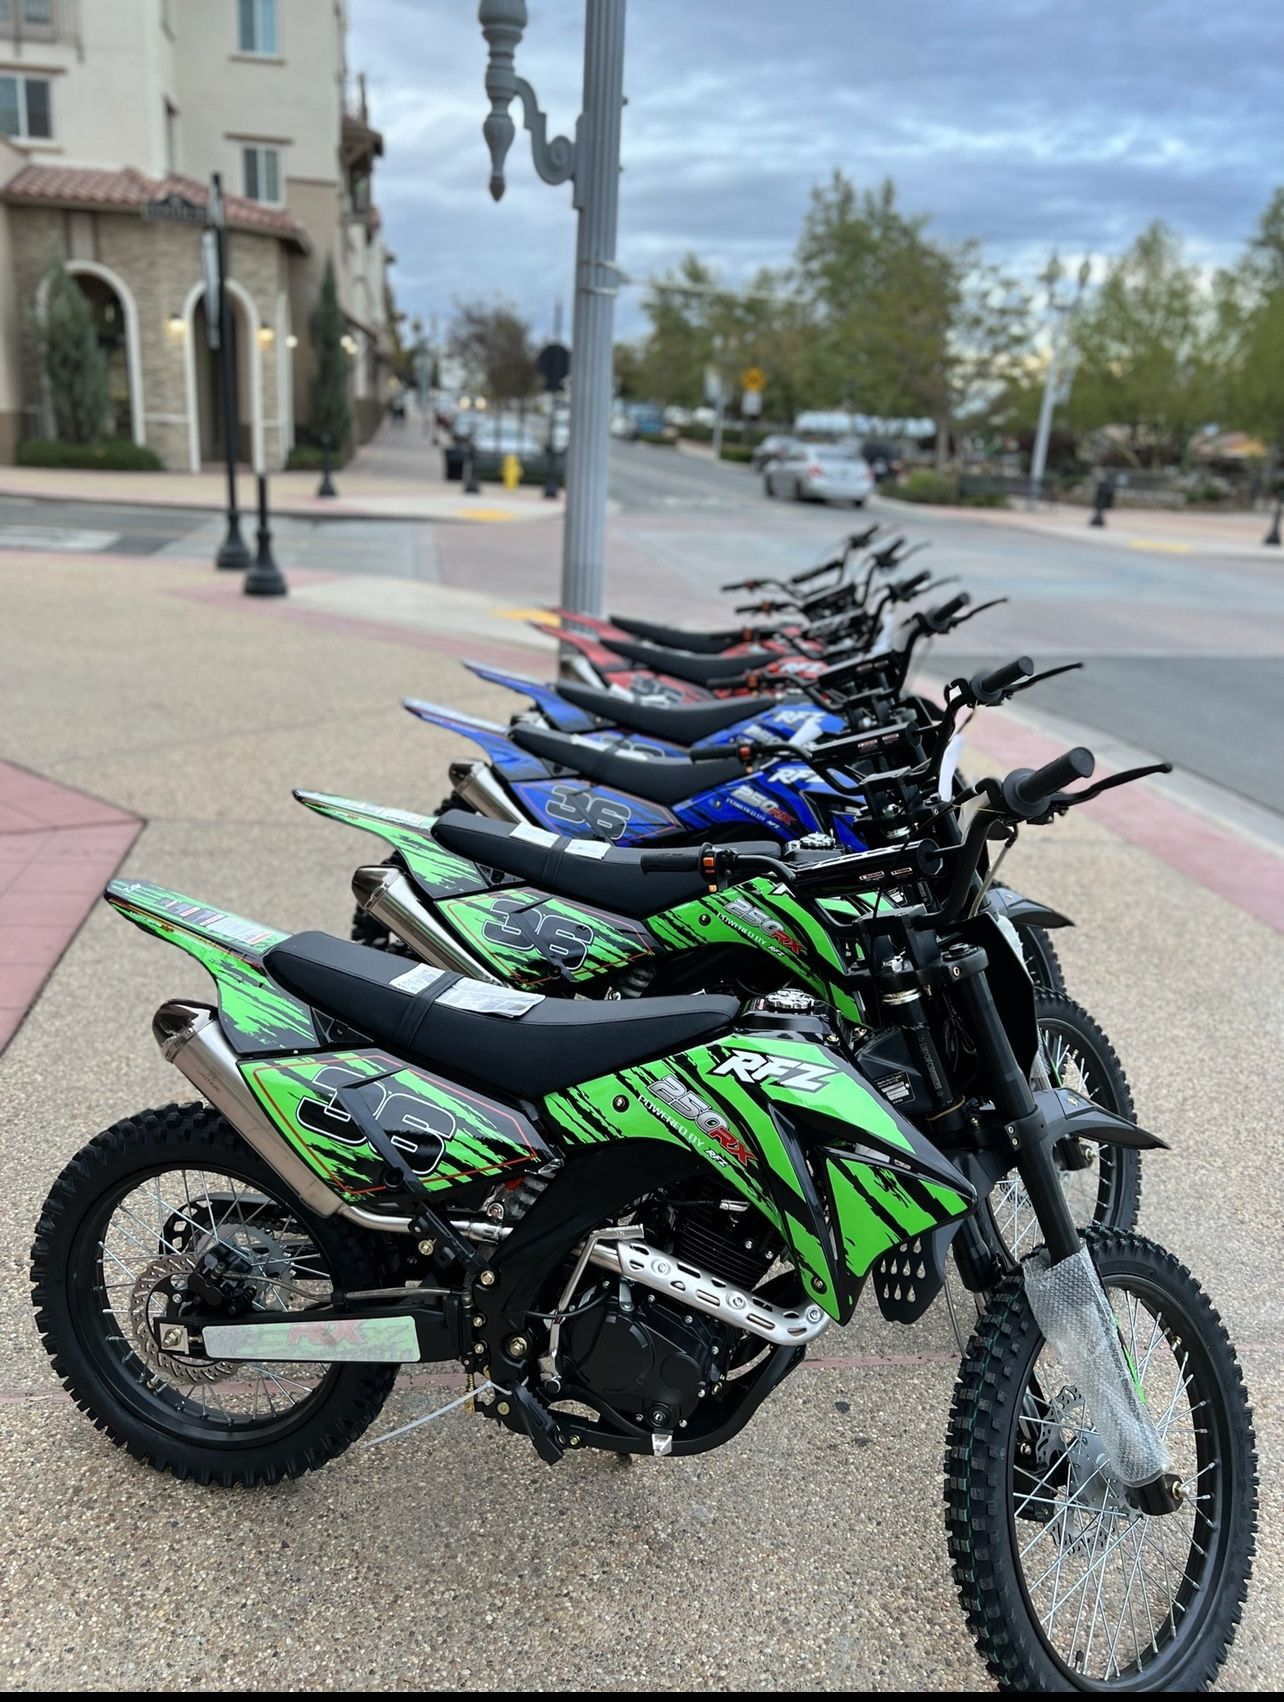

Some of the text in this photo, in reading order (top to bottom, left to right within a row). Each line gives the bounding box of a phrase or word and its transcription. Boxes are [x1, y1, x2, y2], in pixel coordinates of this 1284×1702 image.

[545, 784, 631, 840] 36
[483, 898, 594, 970] 36
[717, 912, 756, 940] POWERED
[768, 946, 785, 957] RFZ
[723, 898, 808, 955] 250RX
[712, 1049, 838, 1093] RFZ
[296, 1066, 456, 1175] 36
[637, 1094, 729, 1168] POWERED BY RFZ
[647, 1074, 759, 1168] 250RX
